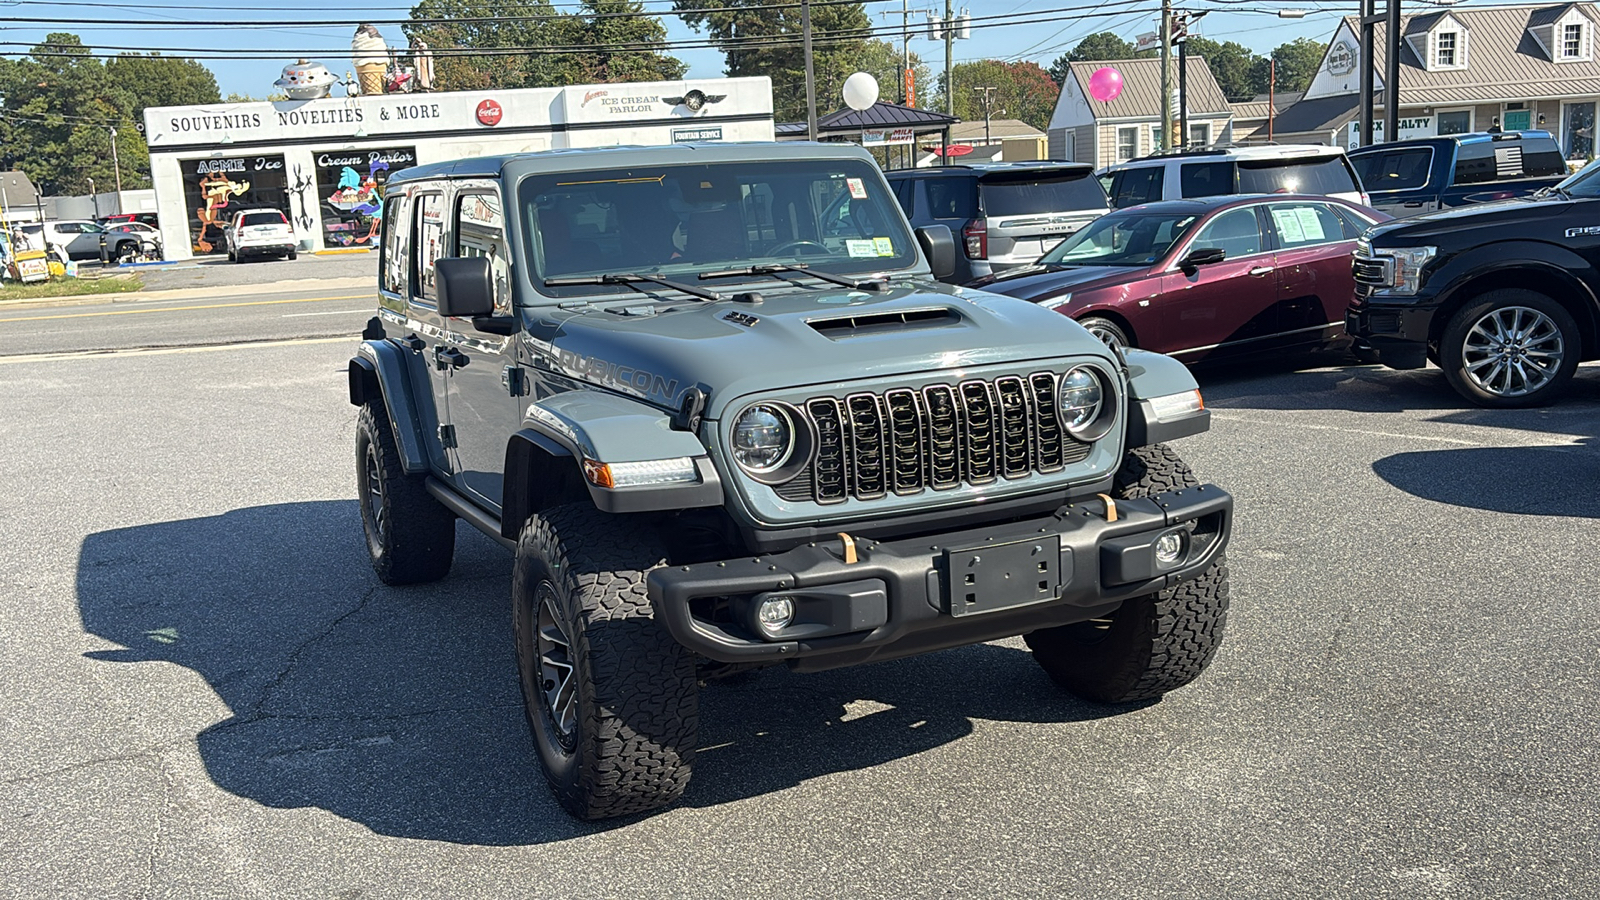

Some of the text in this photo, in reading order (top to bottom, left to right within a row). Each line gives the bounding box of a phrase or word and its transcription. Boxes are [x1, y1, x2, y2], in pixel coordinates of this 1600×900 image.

[601, 95, 659, 105] ICE CREAM
[609, 104, 652, 114] PARLOR
[171, 104, 440, 132] SOUVENIRS NOVELTIES & MORE
[700, 130, 721, 139] SERVICE
[197, 157, 283, 174] ACME Ice
[318, 151, 414, 167] Cream Parlor
[560, 348, 679, 400] RUBICON
